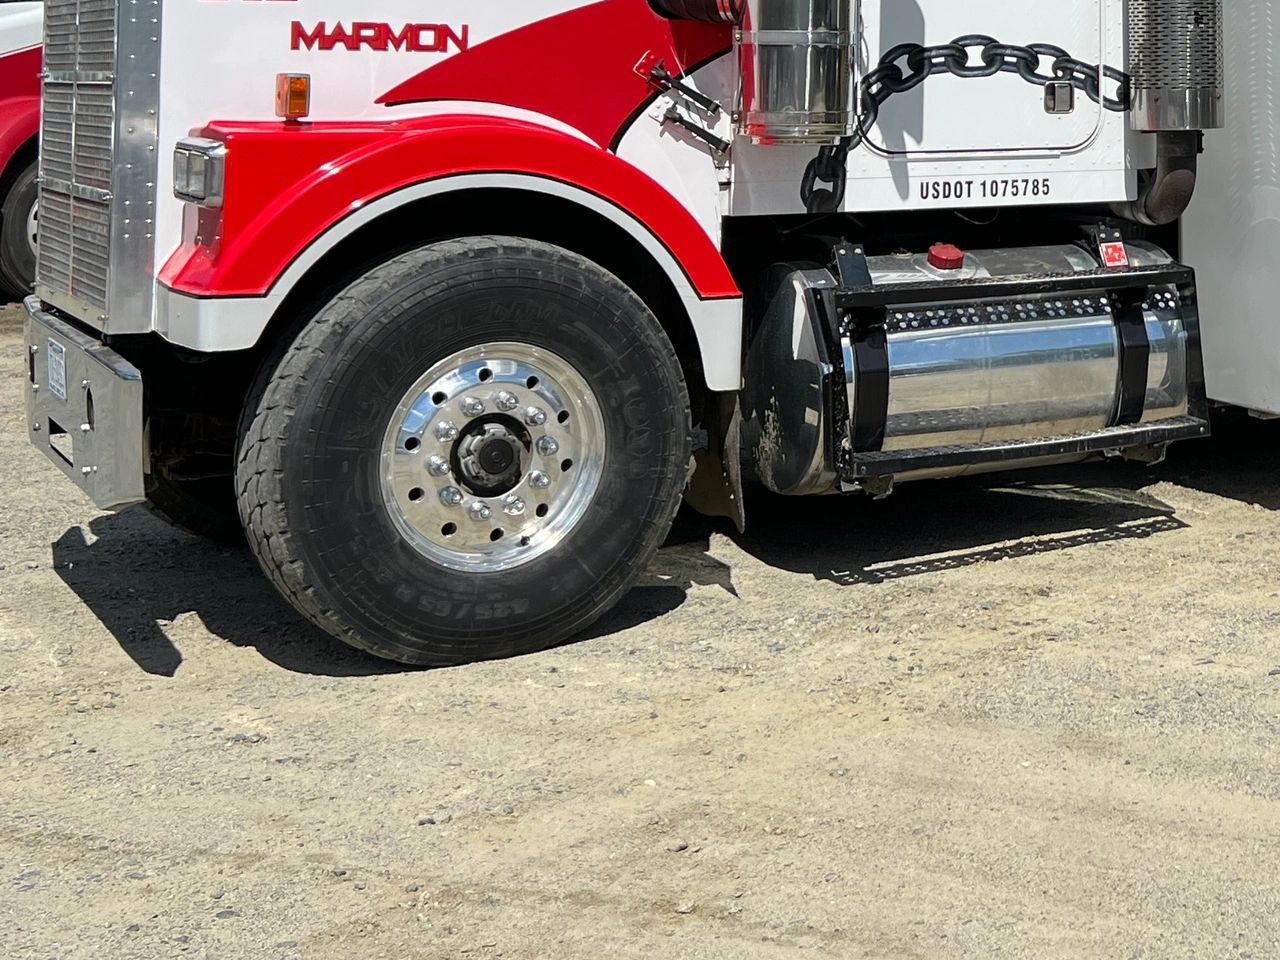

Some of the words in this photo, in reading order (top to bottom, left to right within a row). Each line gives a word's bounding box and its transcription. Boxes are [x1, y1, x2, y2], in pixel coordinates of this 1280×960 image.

[291, 21, 469, 52] MARMON
[920, 180, 974, 200] USDOT
[980, 178, 1050, 198] 1075785
